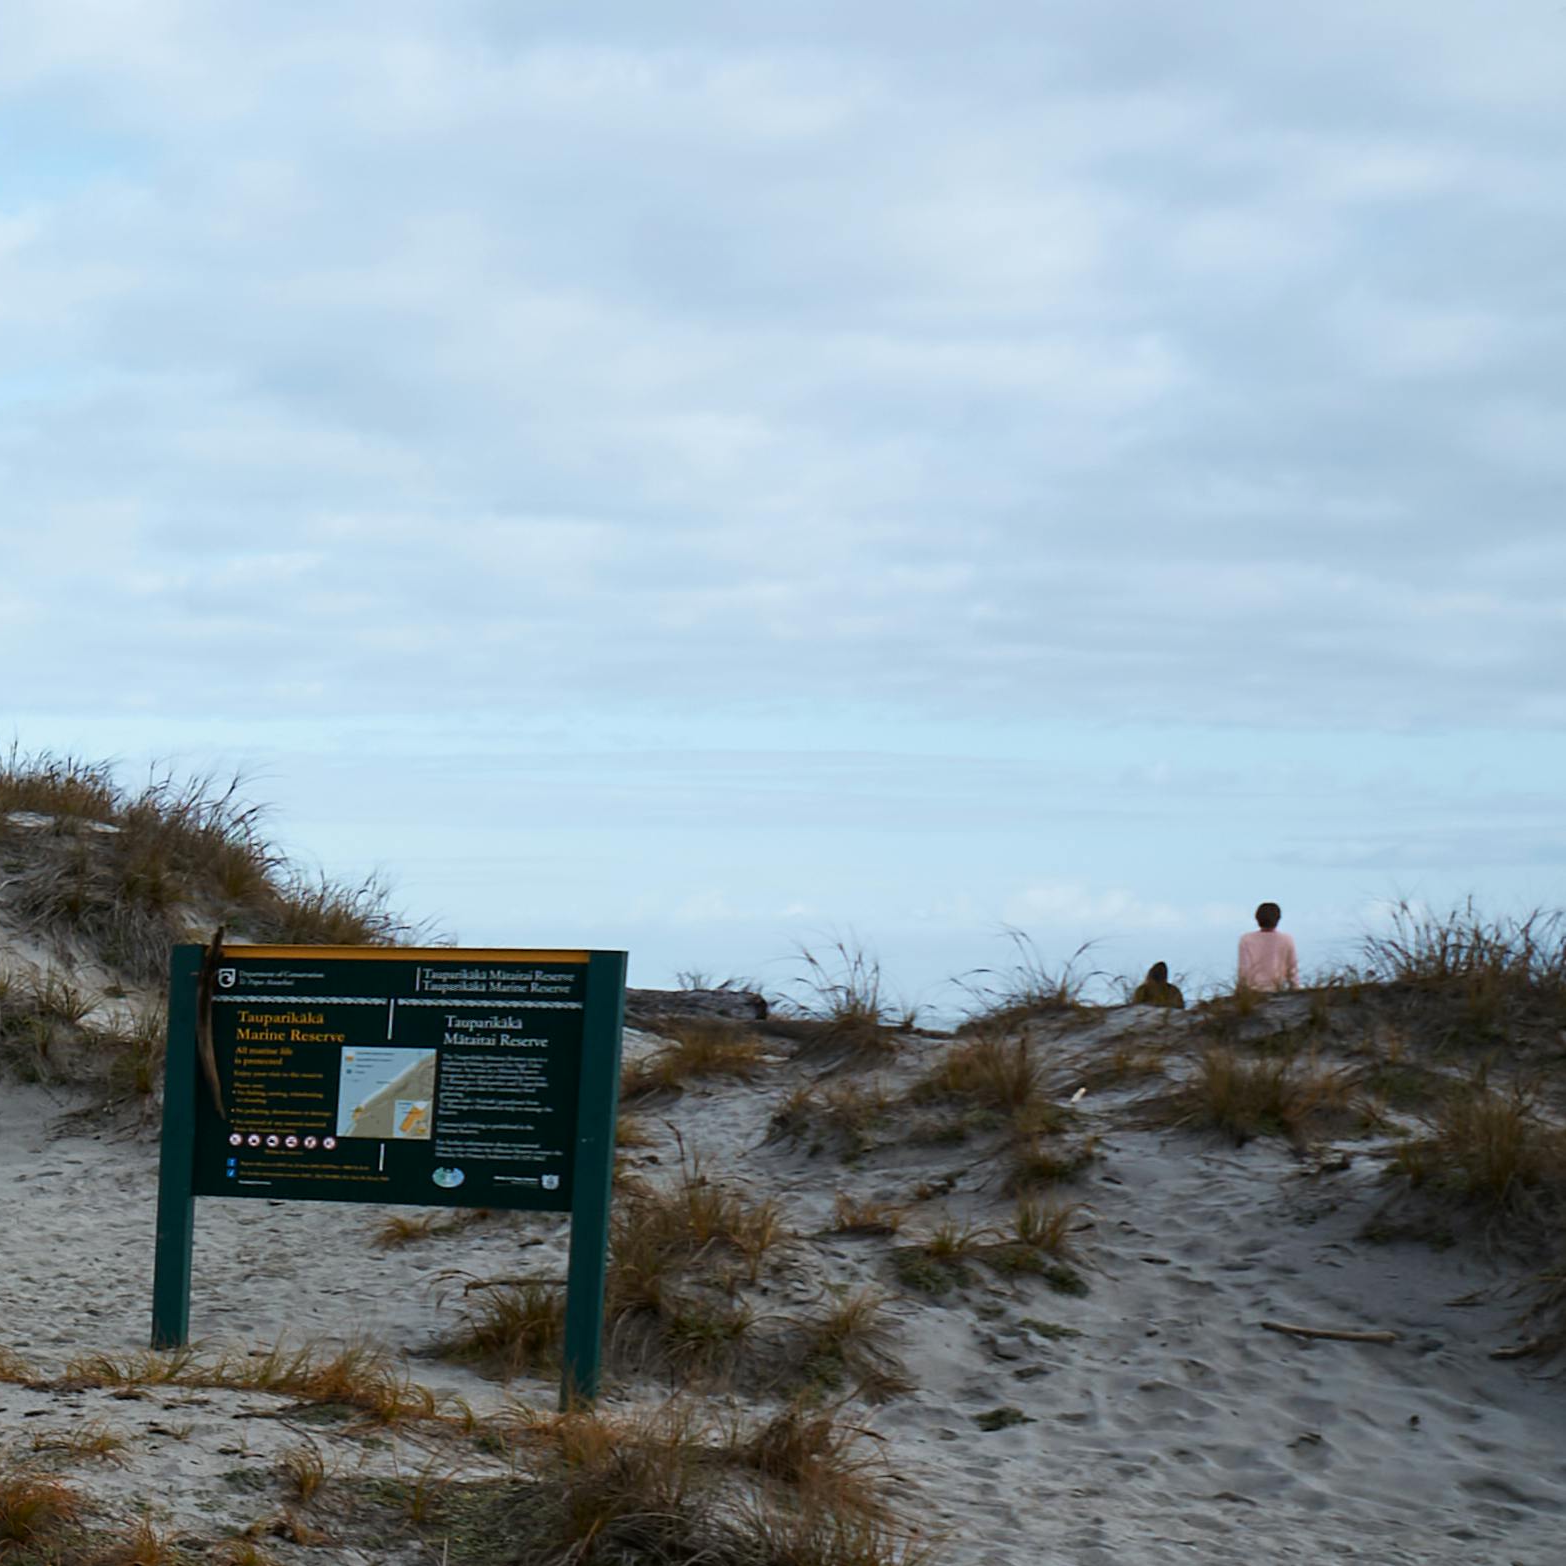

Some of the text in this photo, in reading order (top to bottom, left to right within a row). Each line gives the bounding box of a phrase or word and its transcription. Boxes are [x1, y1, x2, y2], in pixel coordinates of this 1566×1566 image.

[534, 970, 575, 982] Reserve
[488, 981, 527, 992] Marine
[529, 982, 572, 993] Reserve
[236, 1028, 346, 1042] Marine Reserve
[499, 1034, 549, 1047] Reserve
